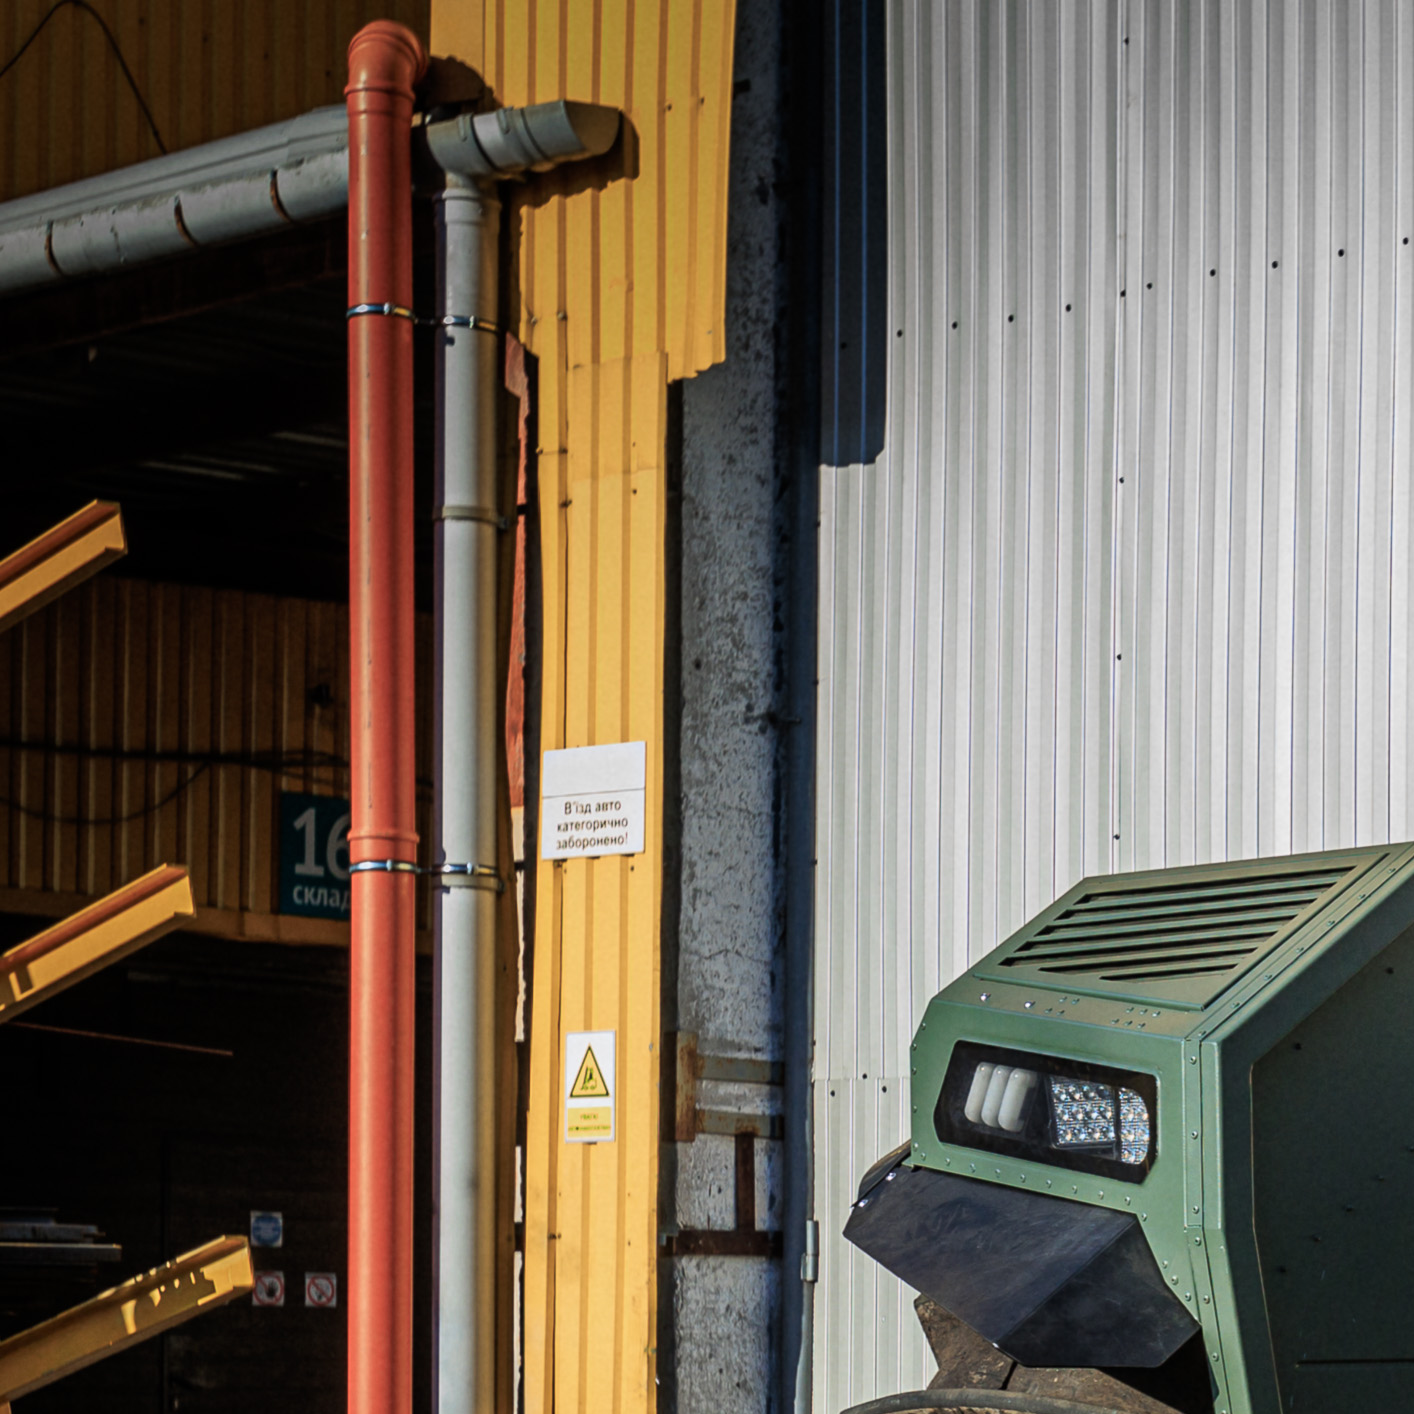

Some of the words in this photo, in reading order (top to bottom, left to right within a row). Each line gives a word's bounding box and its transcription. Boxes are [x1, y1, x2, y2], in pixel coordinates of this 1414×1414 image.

[595, 800, 621, 812] авто
[557, 817, 629, 832] категорично
[556, 832, 628, 850] заборонено!
